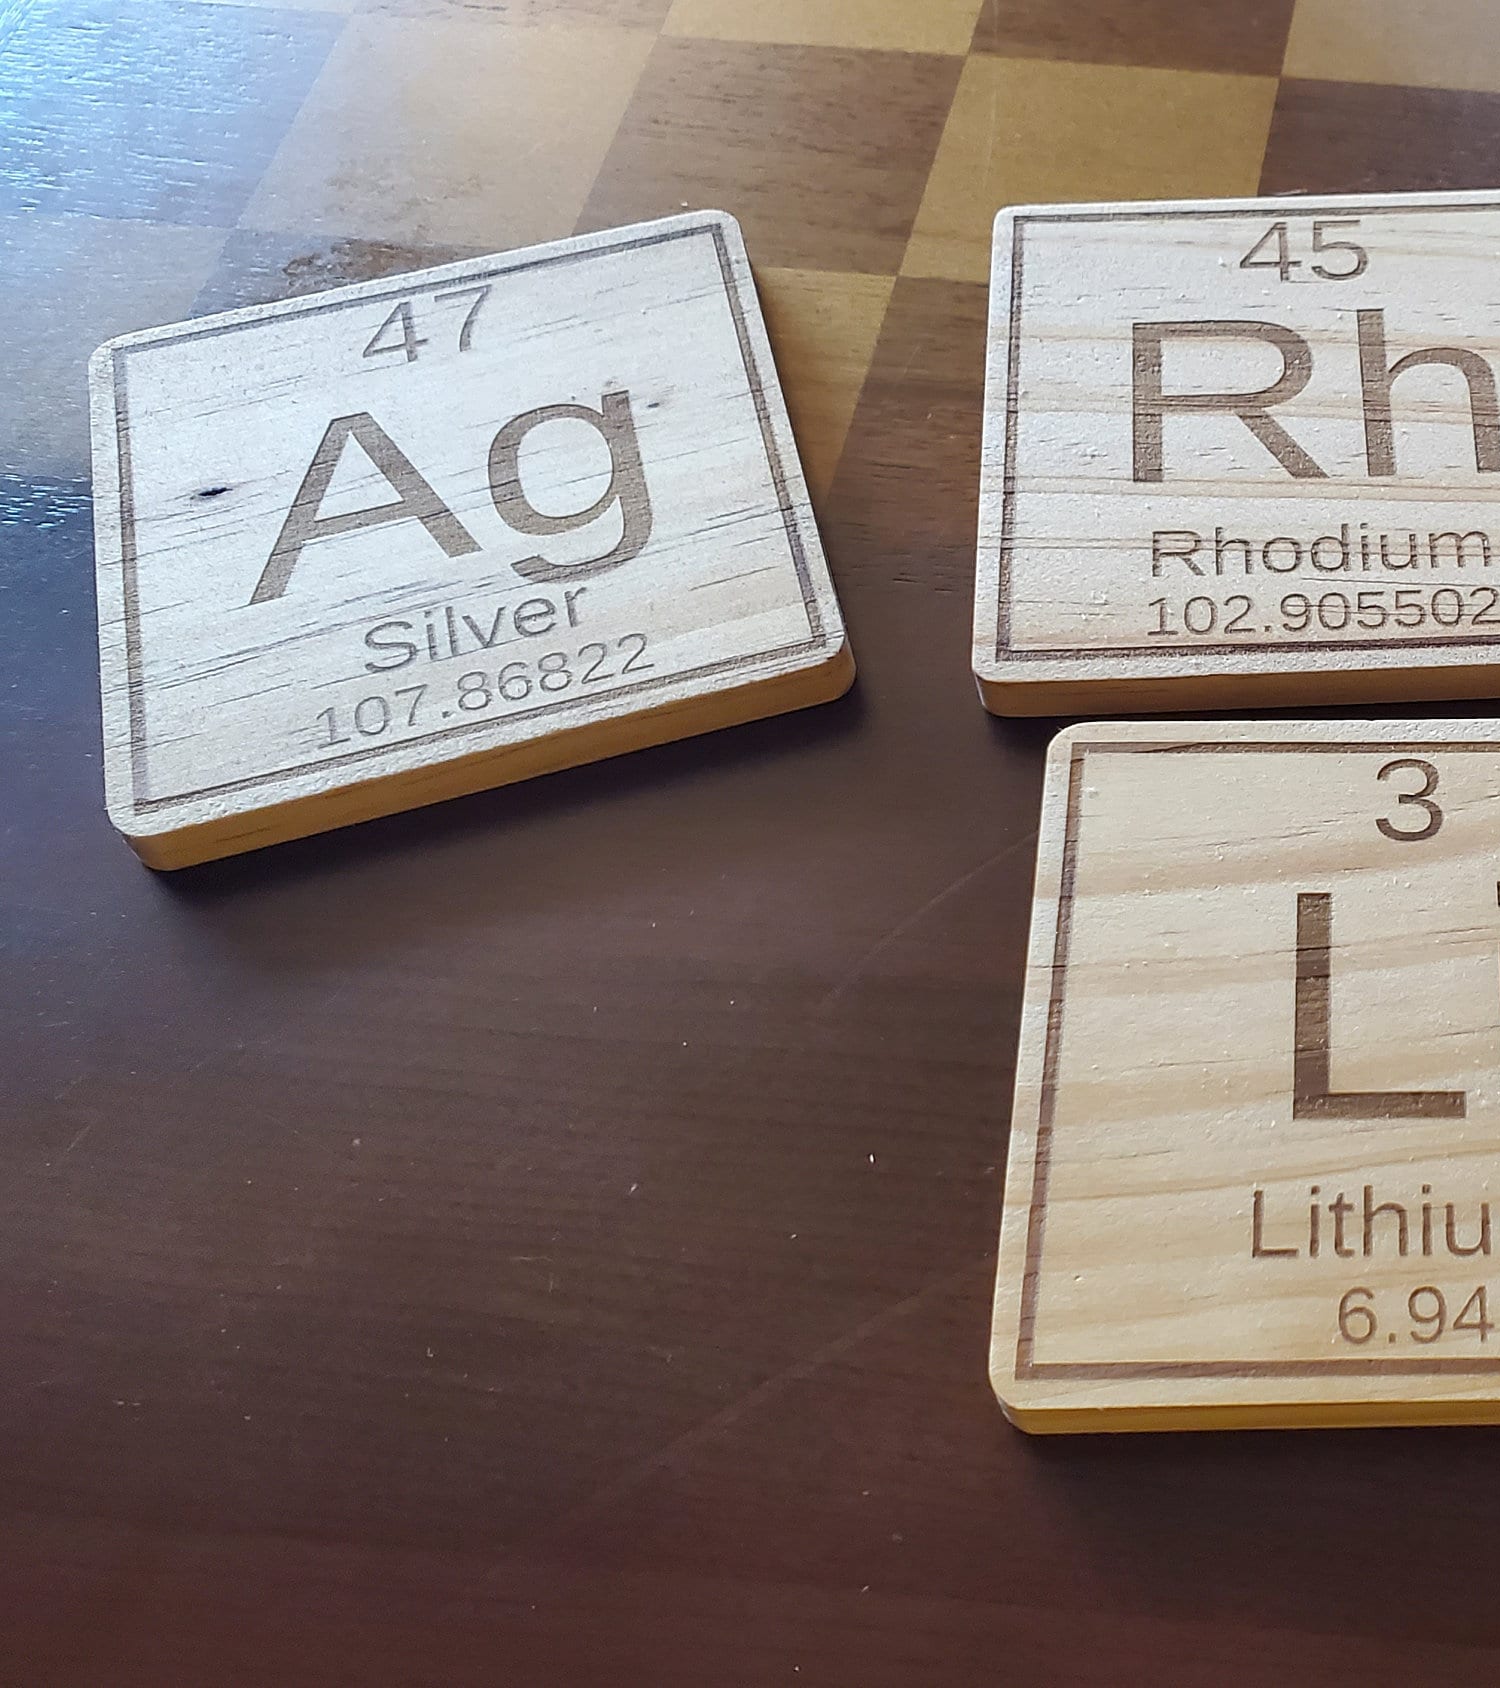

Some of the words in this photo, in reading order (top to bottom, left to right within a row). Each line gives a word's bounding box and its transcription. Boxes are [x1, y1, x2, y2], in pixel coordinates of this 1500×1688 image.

[1239, 219, 1369, 282] 45
[362, 284, 494, 363] 47
[250, 388, 654, 606] Ag
[1151, 523, 1493, 578] Rhodium
[363, 583, 588, 674] Silver
[315, 633, 656, 750] 107.86822
[1374, 758, 1445, 842] 3
[1337, 1285, 1495, 1346] 6.94
